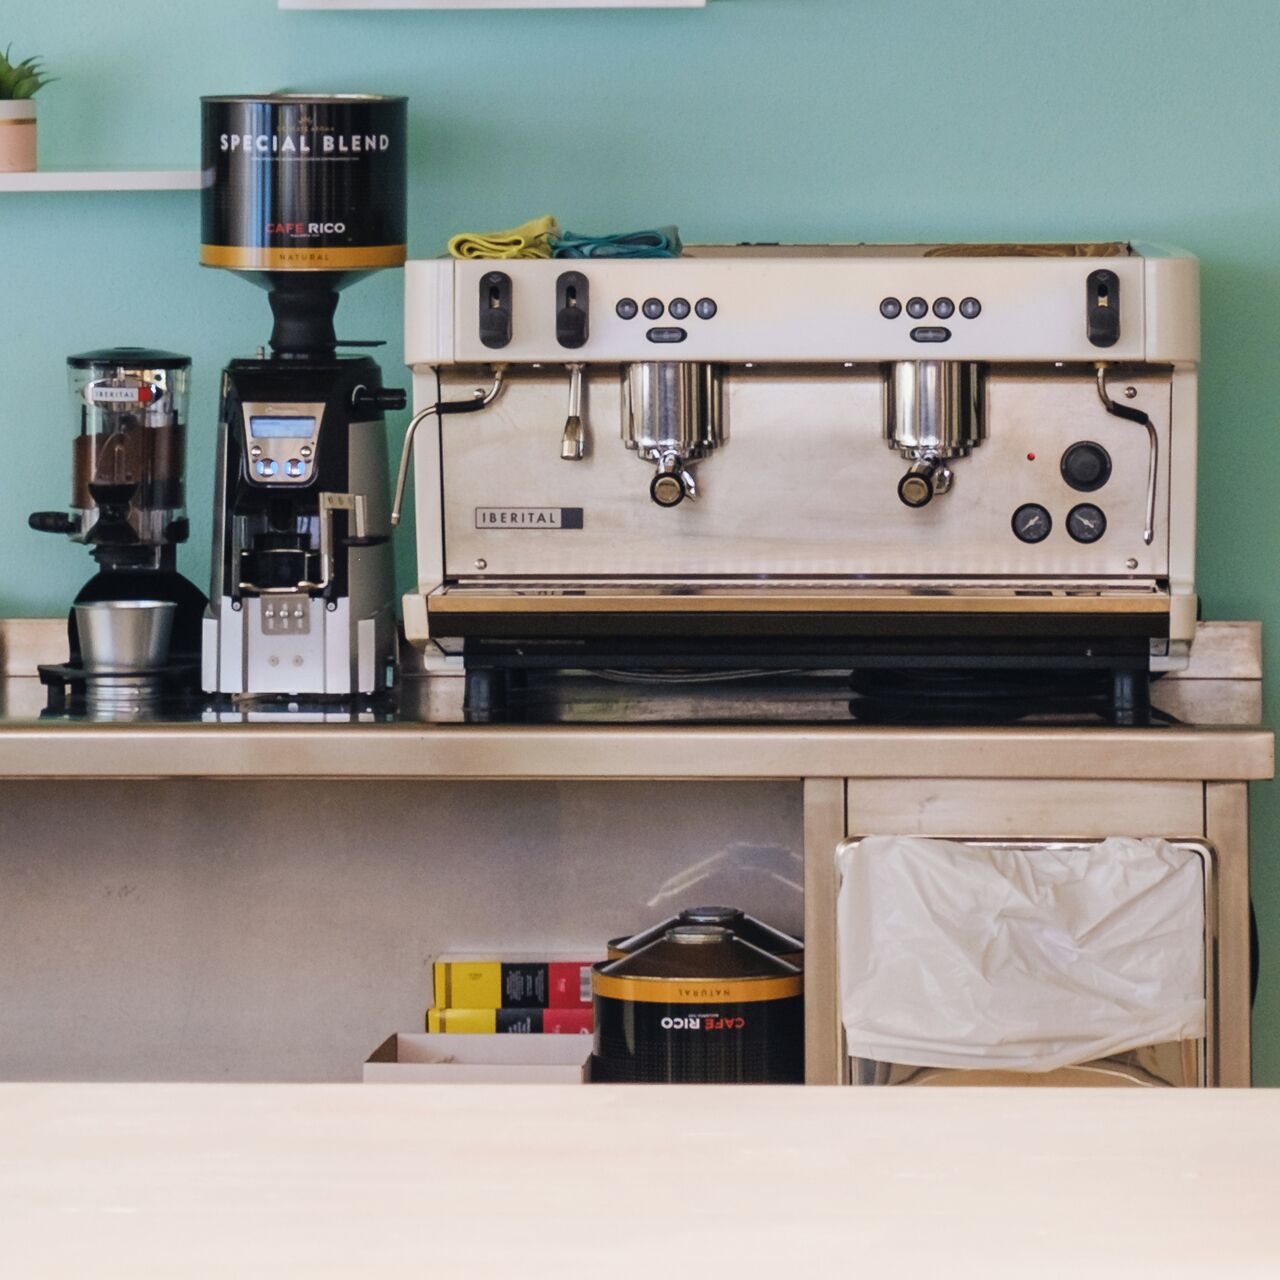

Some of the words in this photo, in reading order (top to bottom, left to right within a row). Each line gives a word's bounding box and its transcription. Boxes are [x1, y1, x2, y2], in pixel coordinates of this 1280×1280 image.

[220, 134, 311, 152] SPECIAL
[323, 134, 391, 152] BLEND
[308, 222, 346, 234] RICO
[279, 253, 330, 262] NATURAL
[95, 390, 136, 399] IBERITAL
[482, 512, 556, 524] IBERITAL
[678, 988, 731, 998] NATURAL
[660, 1017, 701, 1030] RICO
